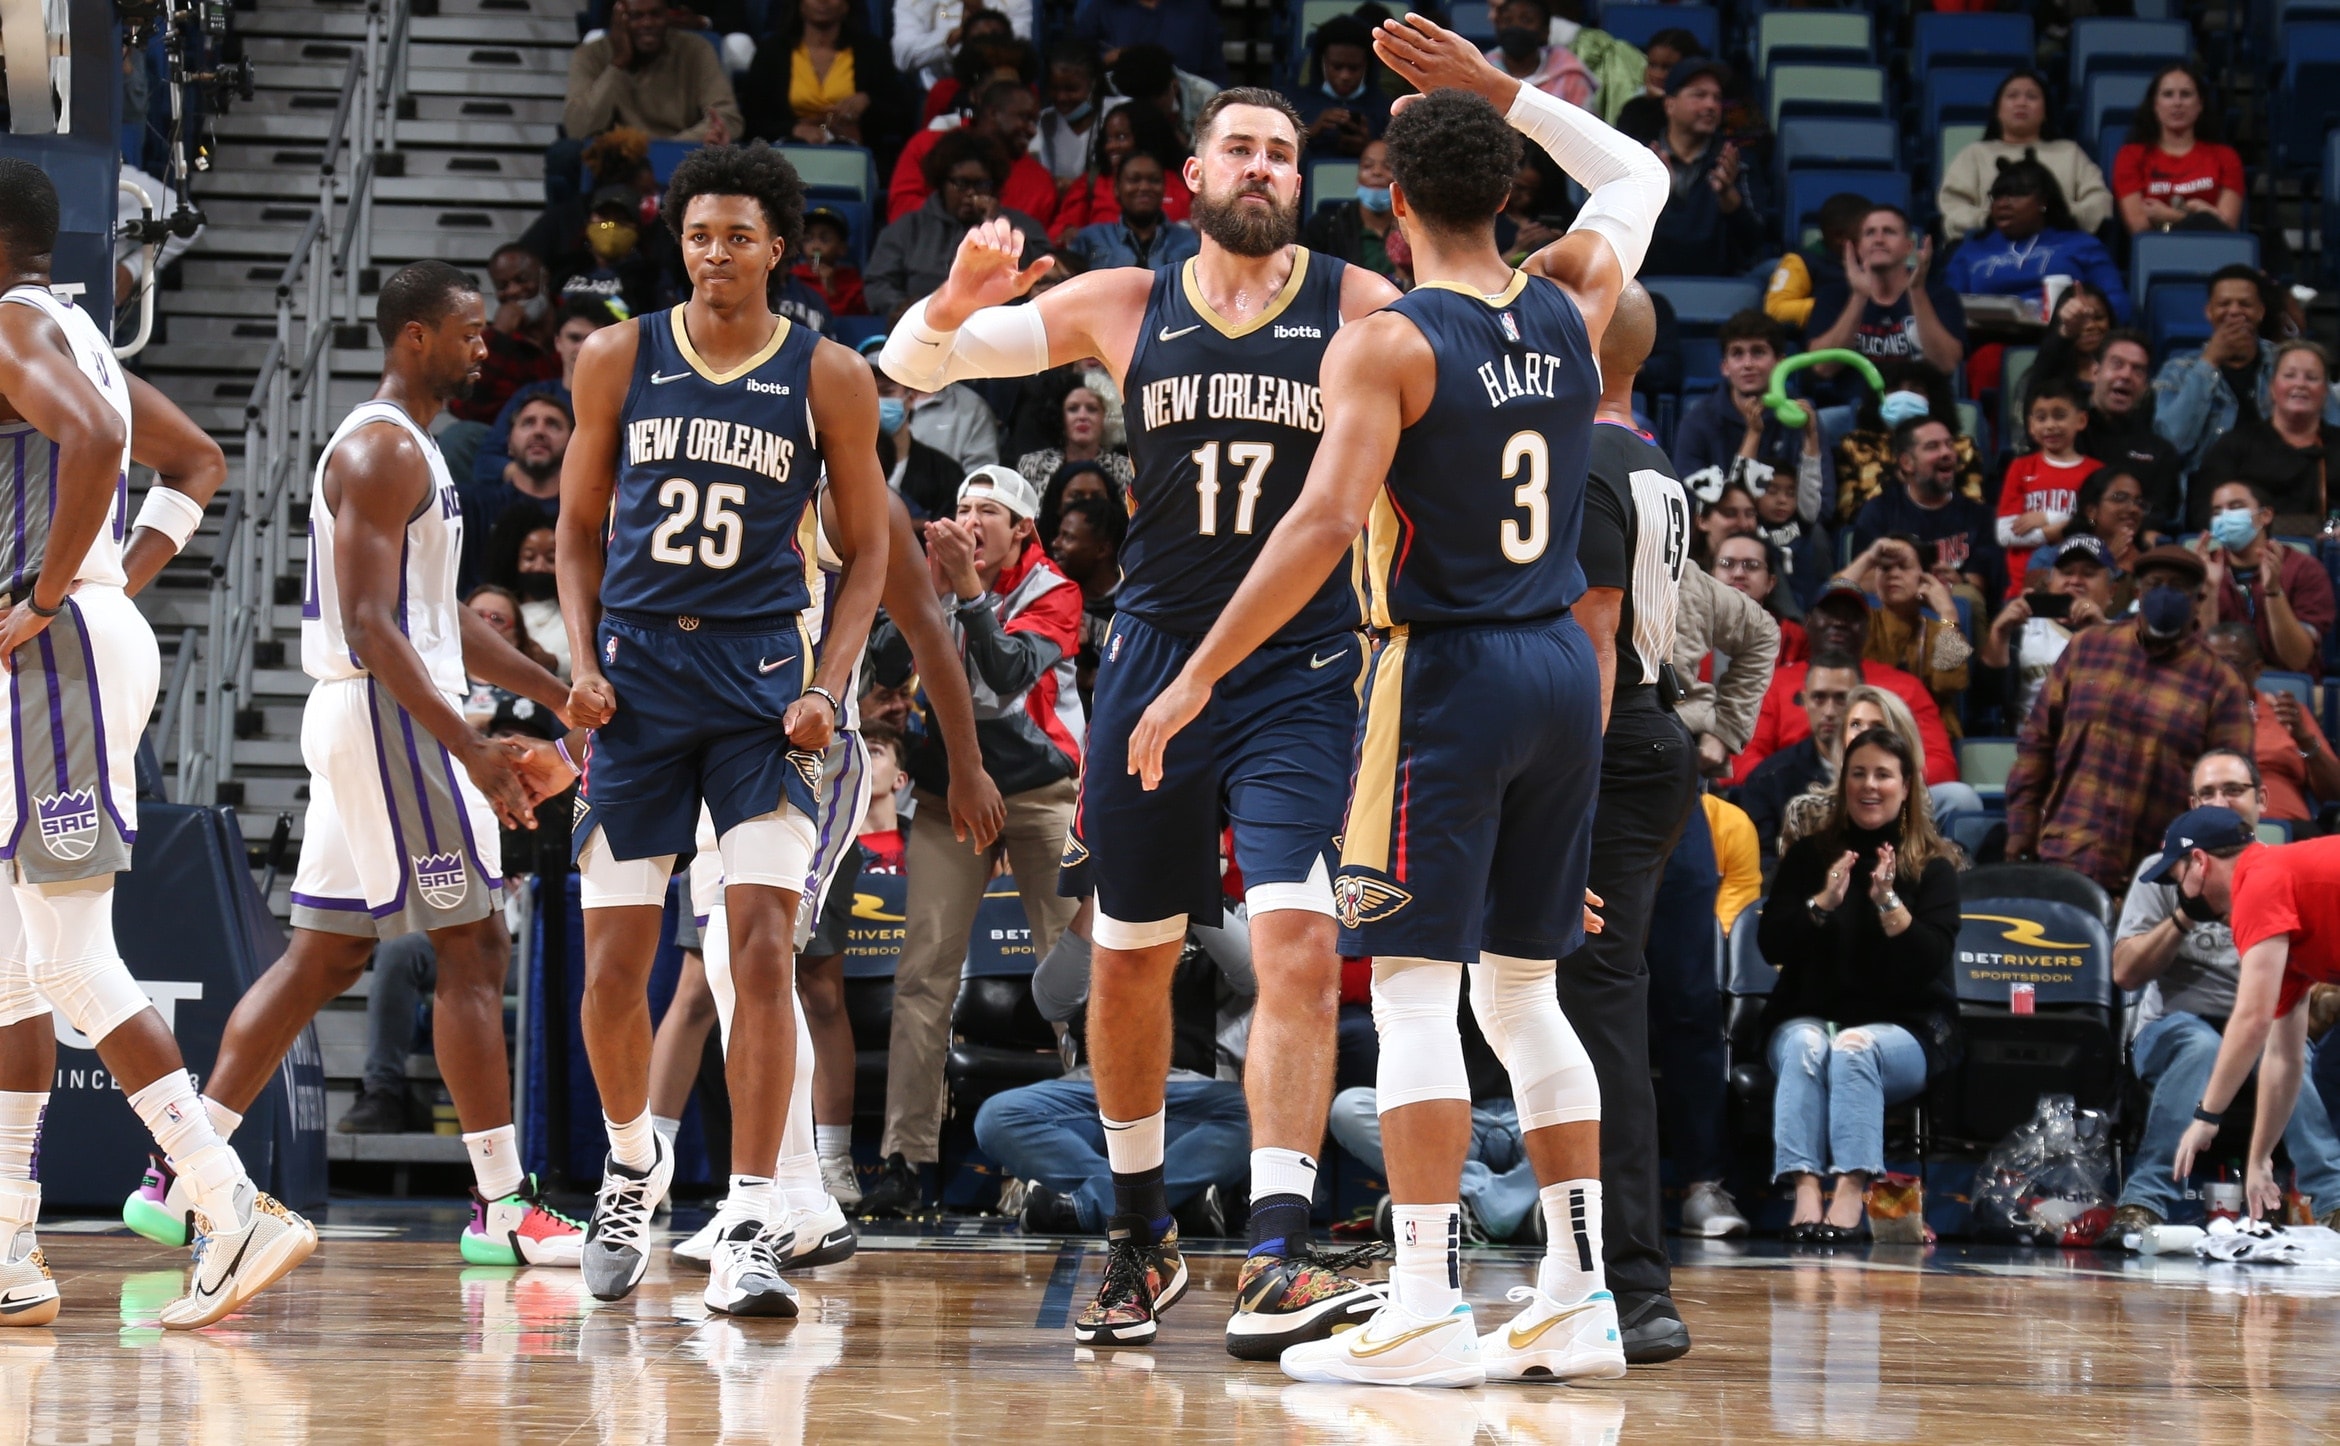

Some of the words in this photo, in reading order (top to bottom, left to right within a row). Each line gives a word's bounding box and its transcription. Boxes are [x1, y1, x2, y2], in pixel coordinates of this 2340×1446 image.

[1273, 325, 1322, 339] ibotta
[1856, 333, 1909, 356] LICANS
[746, 378, 790, 396] ibotta
[1477, 351, 1561, 408] HART
[1141, 374, 1202, 433] NEW
[1207, 372, 1326, 434] ORLEANS
[628, 416, 684, 467] NEW
[686, 416, 795, 484] ORLEANS
[1191, 440, 1275, 536] 17
[1500, 429, 1550, 565] 3
[2025, 487, 2078, 515] PELICA
[650, 476, 747, 570] 25
[41, 812, 98, 836] SAC
[418, 871, 465, 888] SAC
[847, 928, 906, 940] RIVER
[1959, 951, 2084, 968] BETRIVERS
[1969, 969, 2074, 983] SPORTSBOOK
[57, 1068, 122, 1090] INCE
